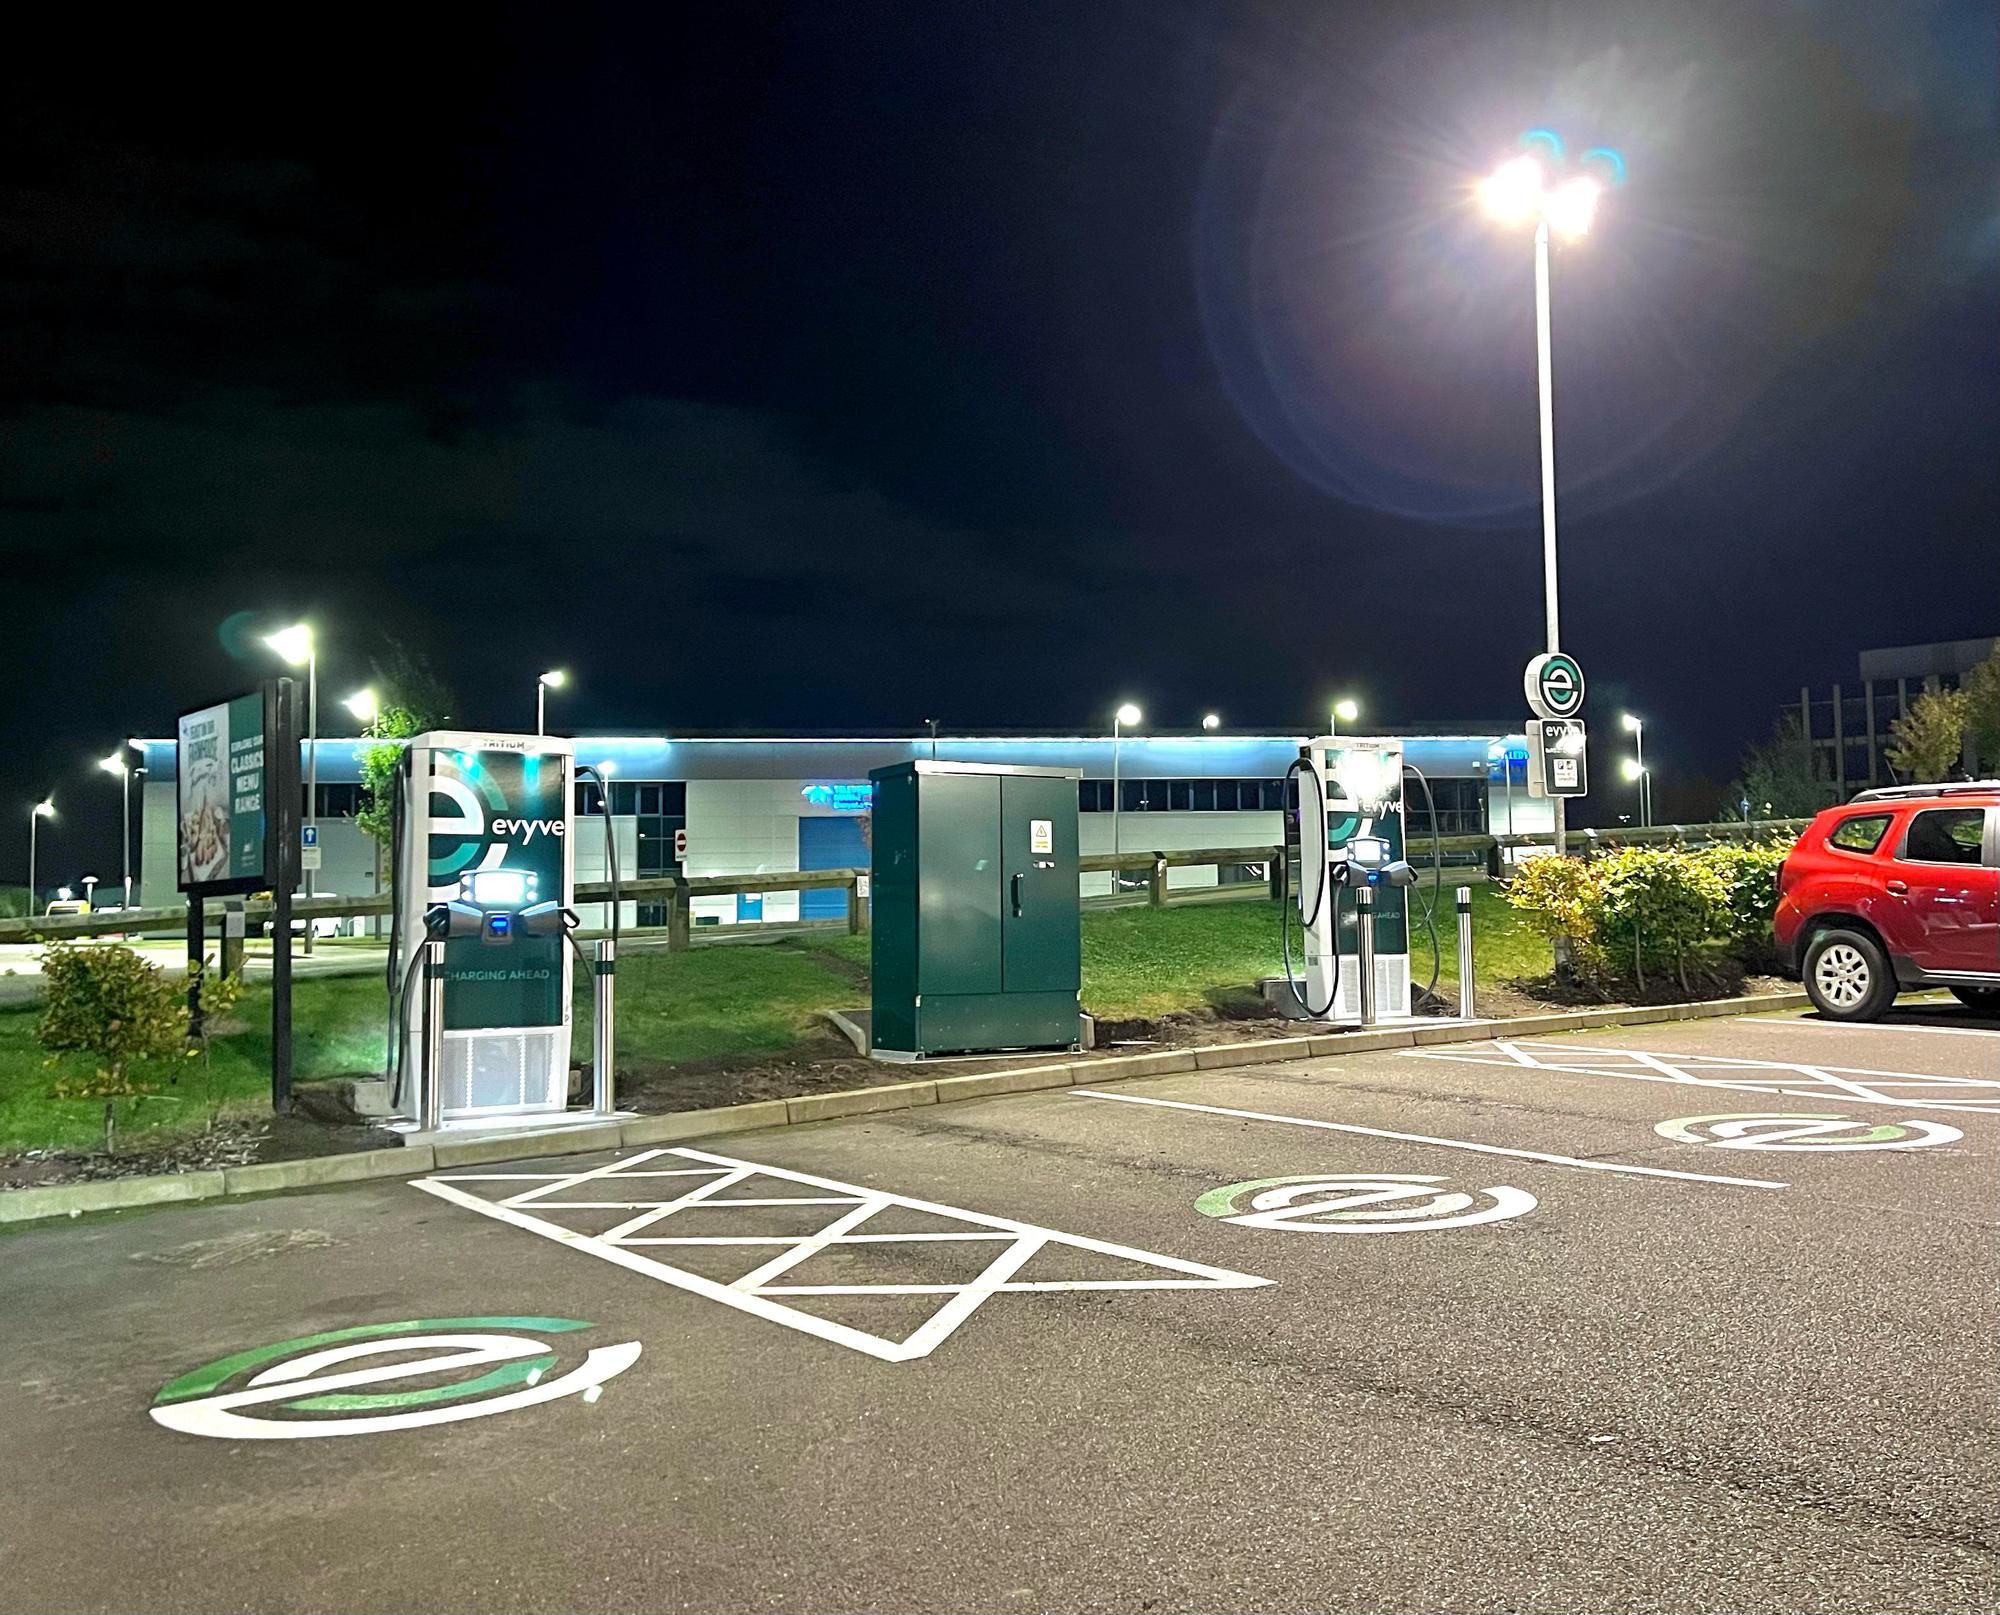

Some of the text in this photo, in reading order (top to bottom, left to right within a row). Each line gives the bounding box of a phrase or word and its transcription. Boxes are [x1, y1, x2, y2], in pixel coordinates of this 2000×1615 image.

[1546, 725, 1581, 741] evy
[231, 749, 264, 774] CLASSICS
[236, 772, 259, 793] MENU
[235, 793, 260, 814] RANGE
[1362, 800, 1403, 821] evyve
[492, 818, 565, 846] evyve
[1377, 911, 1401, 920] AHEAD
[508, 969, 550, 980] AHEAD
